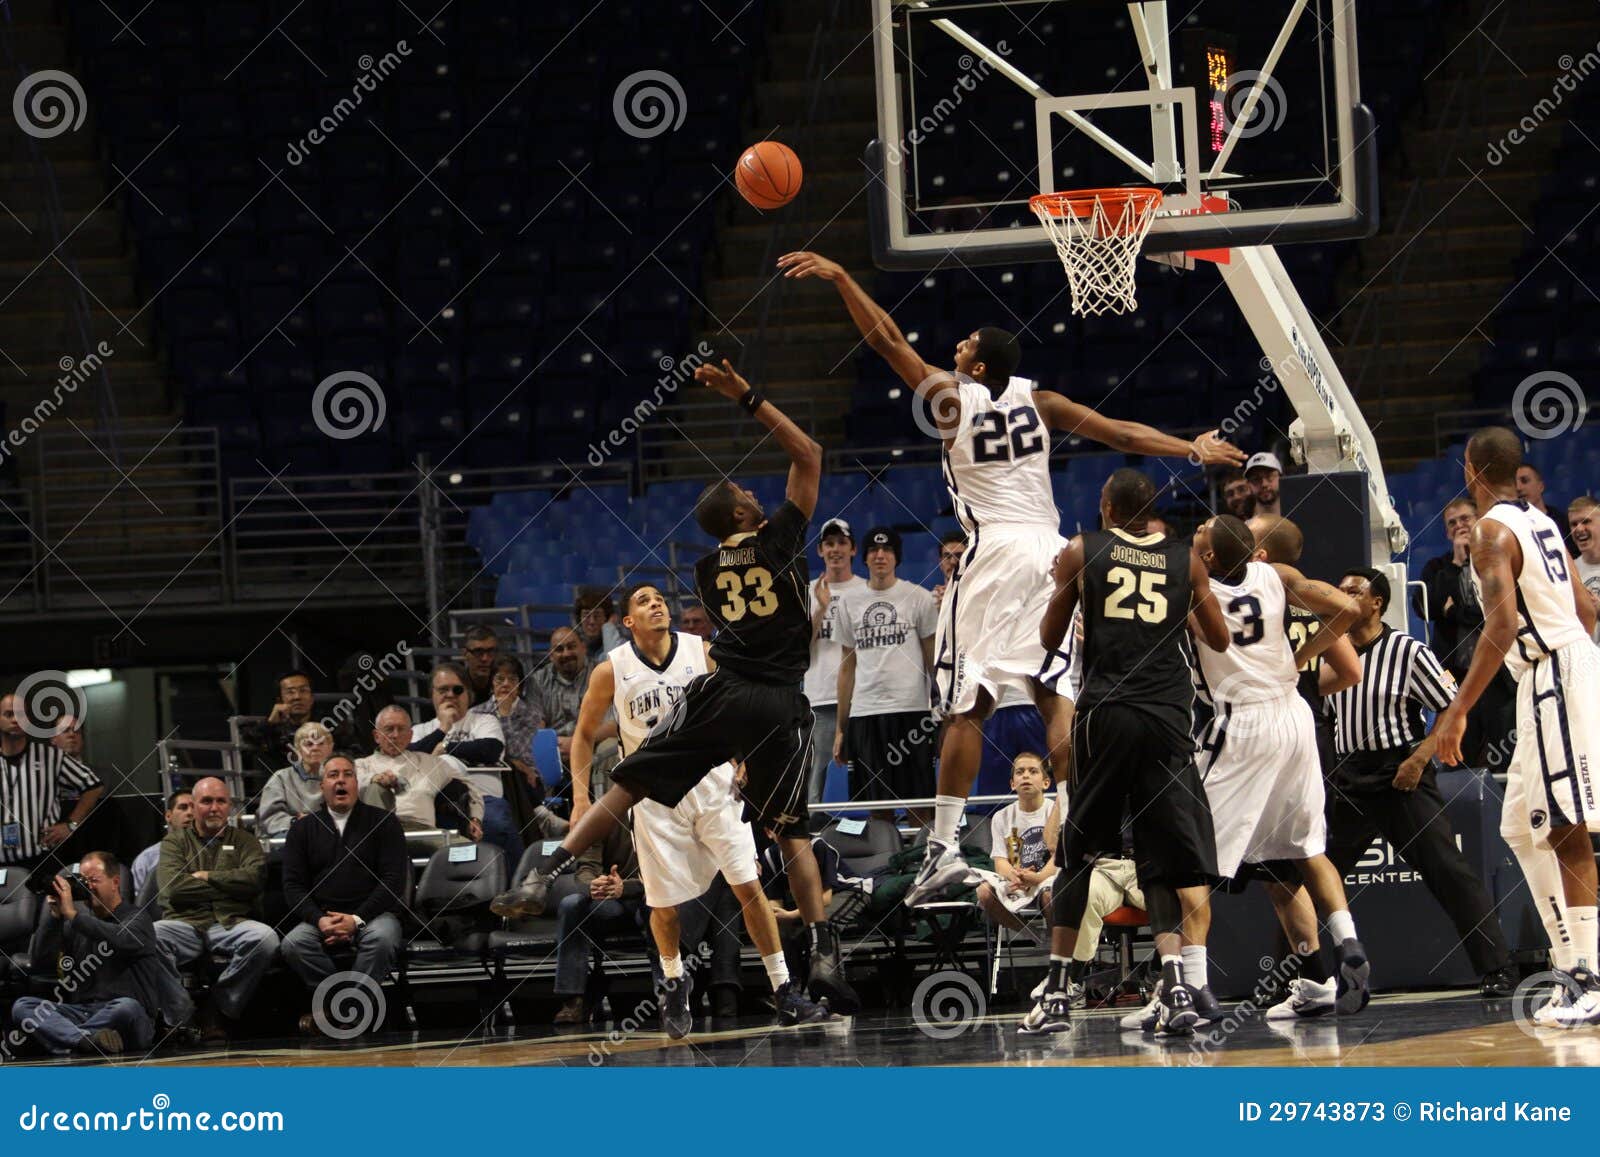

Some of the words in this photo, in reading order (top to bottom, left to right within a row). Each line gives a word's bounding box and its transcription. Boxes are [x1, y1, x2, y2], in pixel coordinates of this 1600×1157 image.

[972, 405, 1044, 462] 22
[719, 547, 756, 567] MOORE
[1110, 545, 1166, 569] JOHNSON
[1531, 528, 1568, 583] 15
[715, 567, 779, 621] 33
[1104, 566, 1168, 623] 25
[1228, 595, 1265, 647] 3
[629, 688, 661, 720] PENN
[666, 685, 687, 706] ST
[1579, 754, 1591, 784] STATE
[1344, 871, 1423, 885] CENTER
